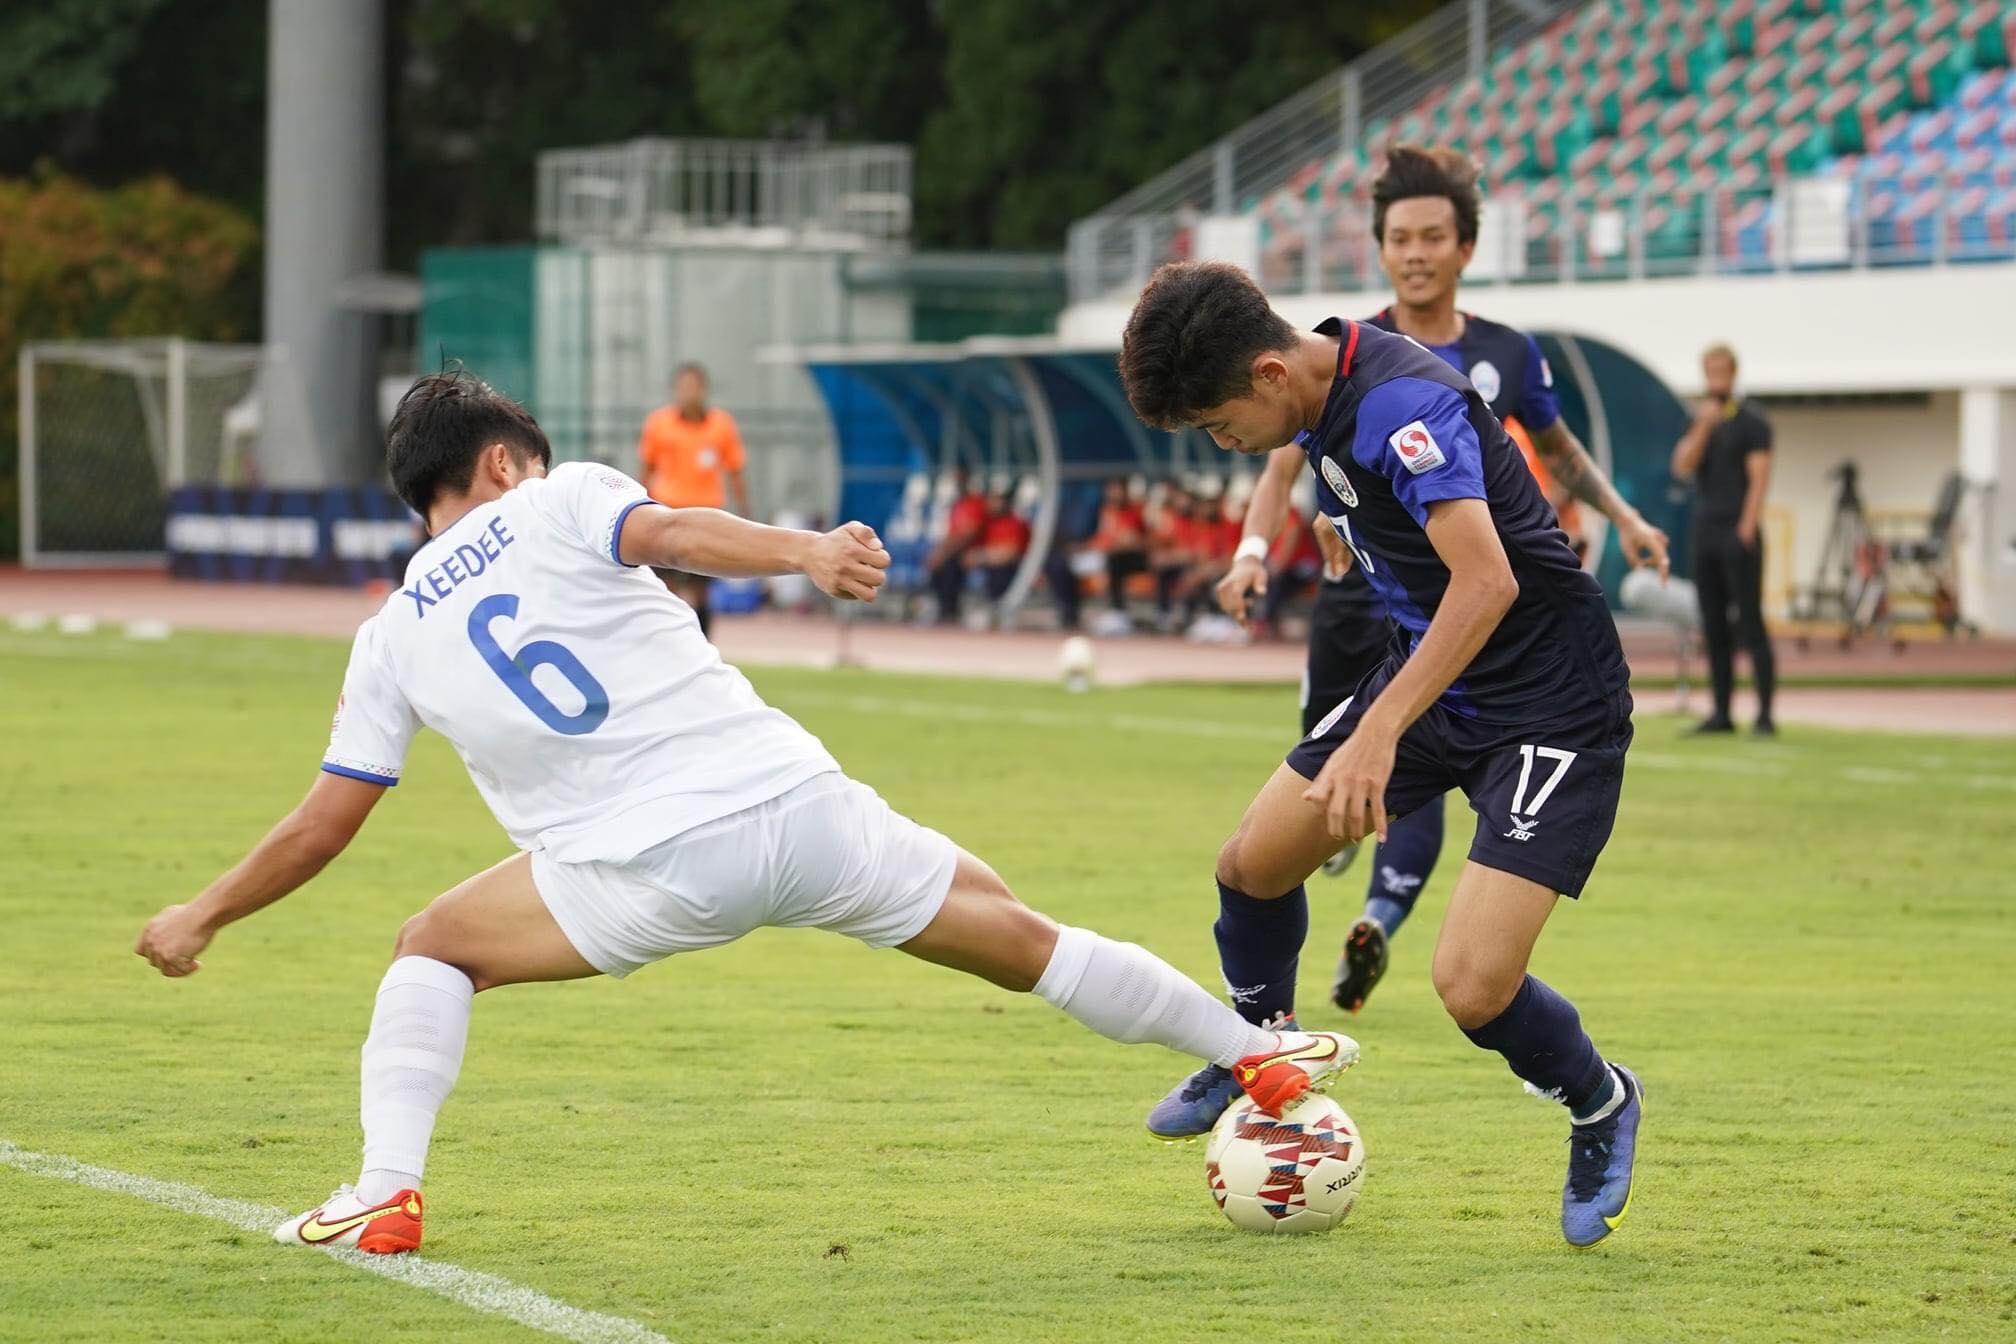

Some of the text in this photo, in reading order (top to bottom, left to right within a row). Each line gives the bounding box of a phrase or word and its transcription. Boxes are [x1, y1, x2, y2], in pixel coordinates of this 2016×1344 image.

[402, 515, 515, 619] XEEDEE
[467, 594, 609, 736] 6
[1510, 744, 1578, 816] 17
[1503, 828, 1535, 842] FBT
